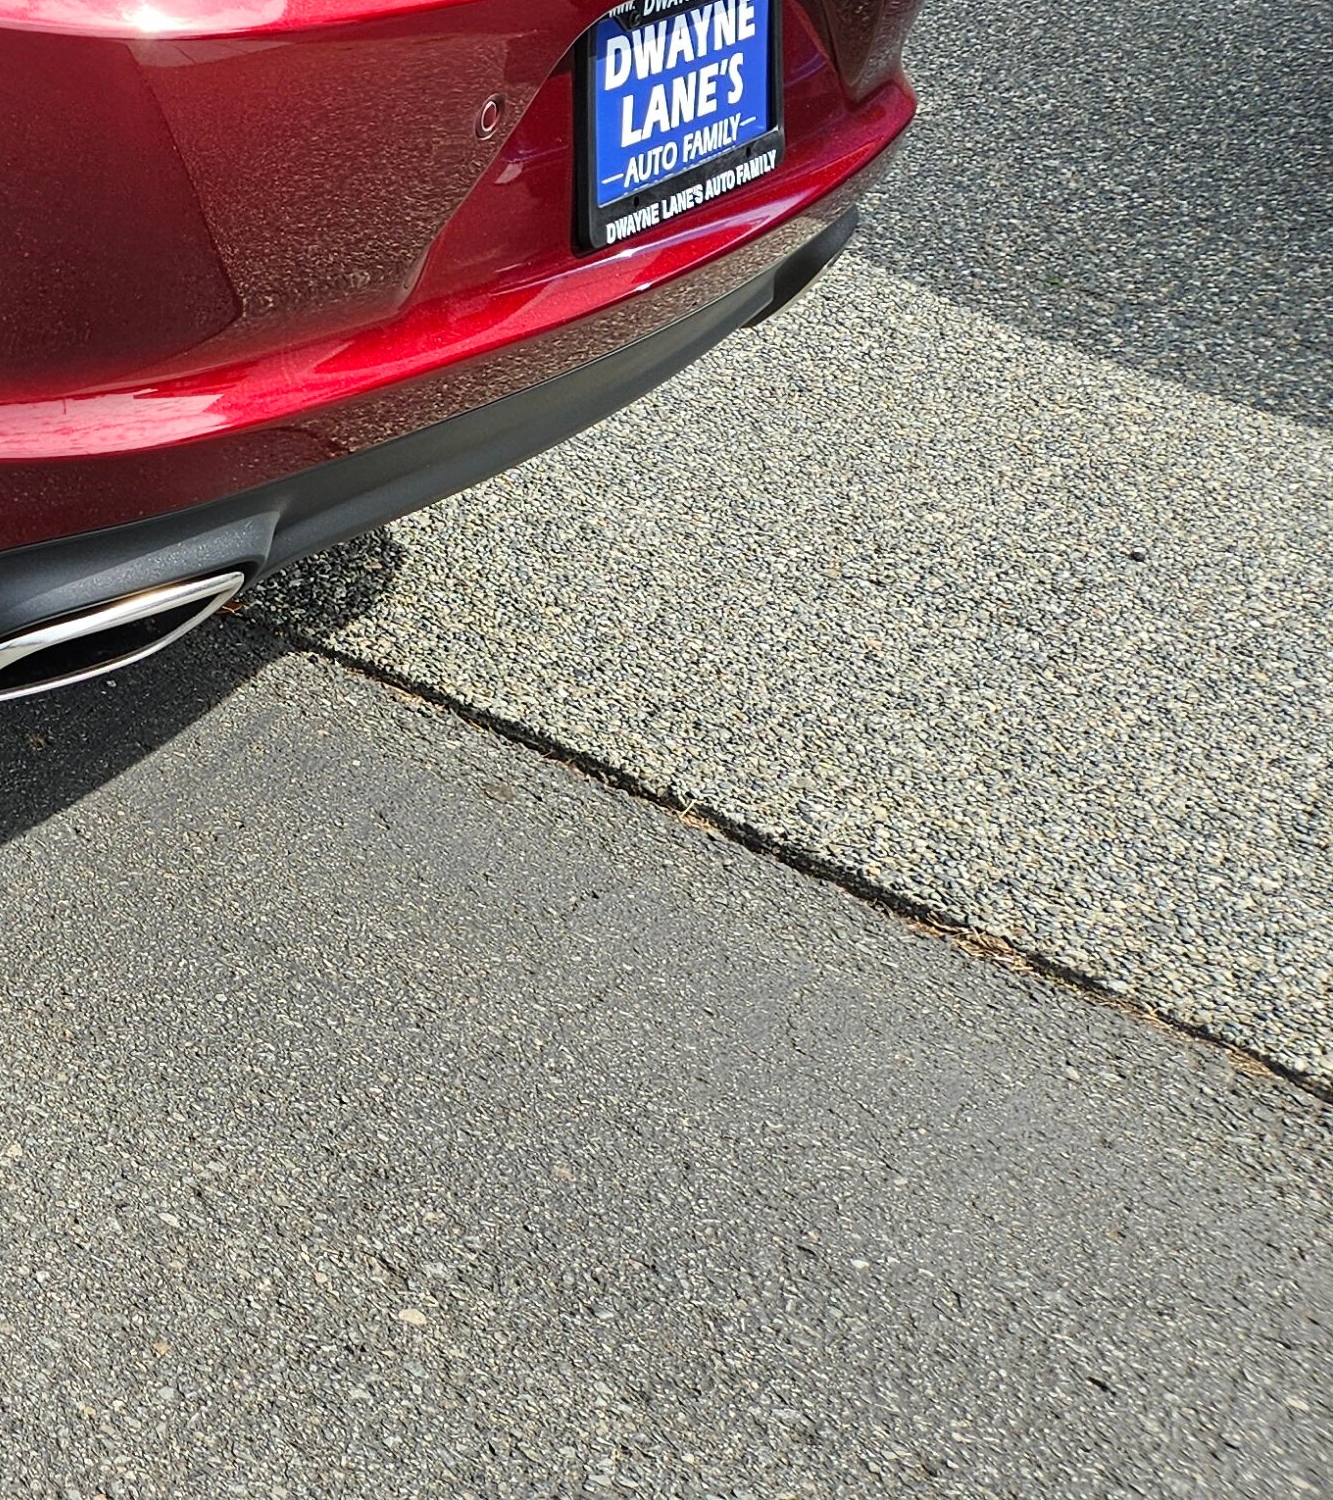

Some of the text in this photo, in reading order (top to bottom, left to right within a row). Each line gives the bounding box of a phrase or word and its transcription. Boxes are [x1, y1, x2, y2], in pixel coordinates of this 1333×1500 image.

[621, 52, 744, 148] LANE'S
[606, 149, 777, 244] DWAYNE LANE'S AUTO FAMILY
[623, 112, 742, 188] AUTO FAMILY
